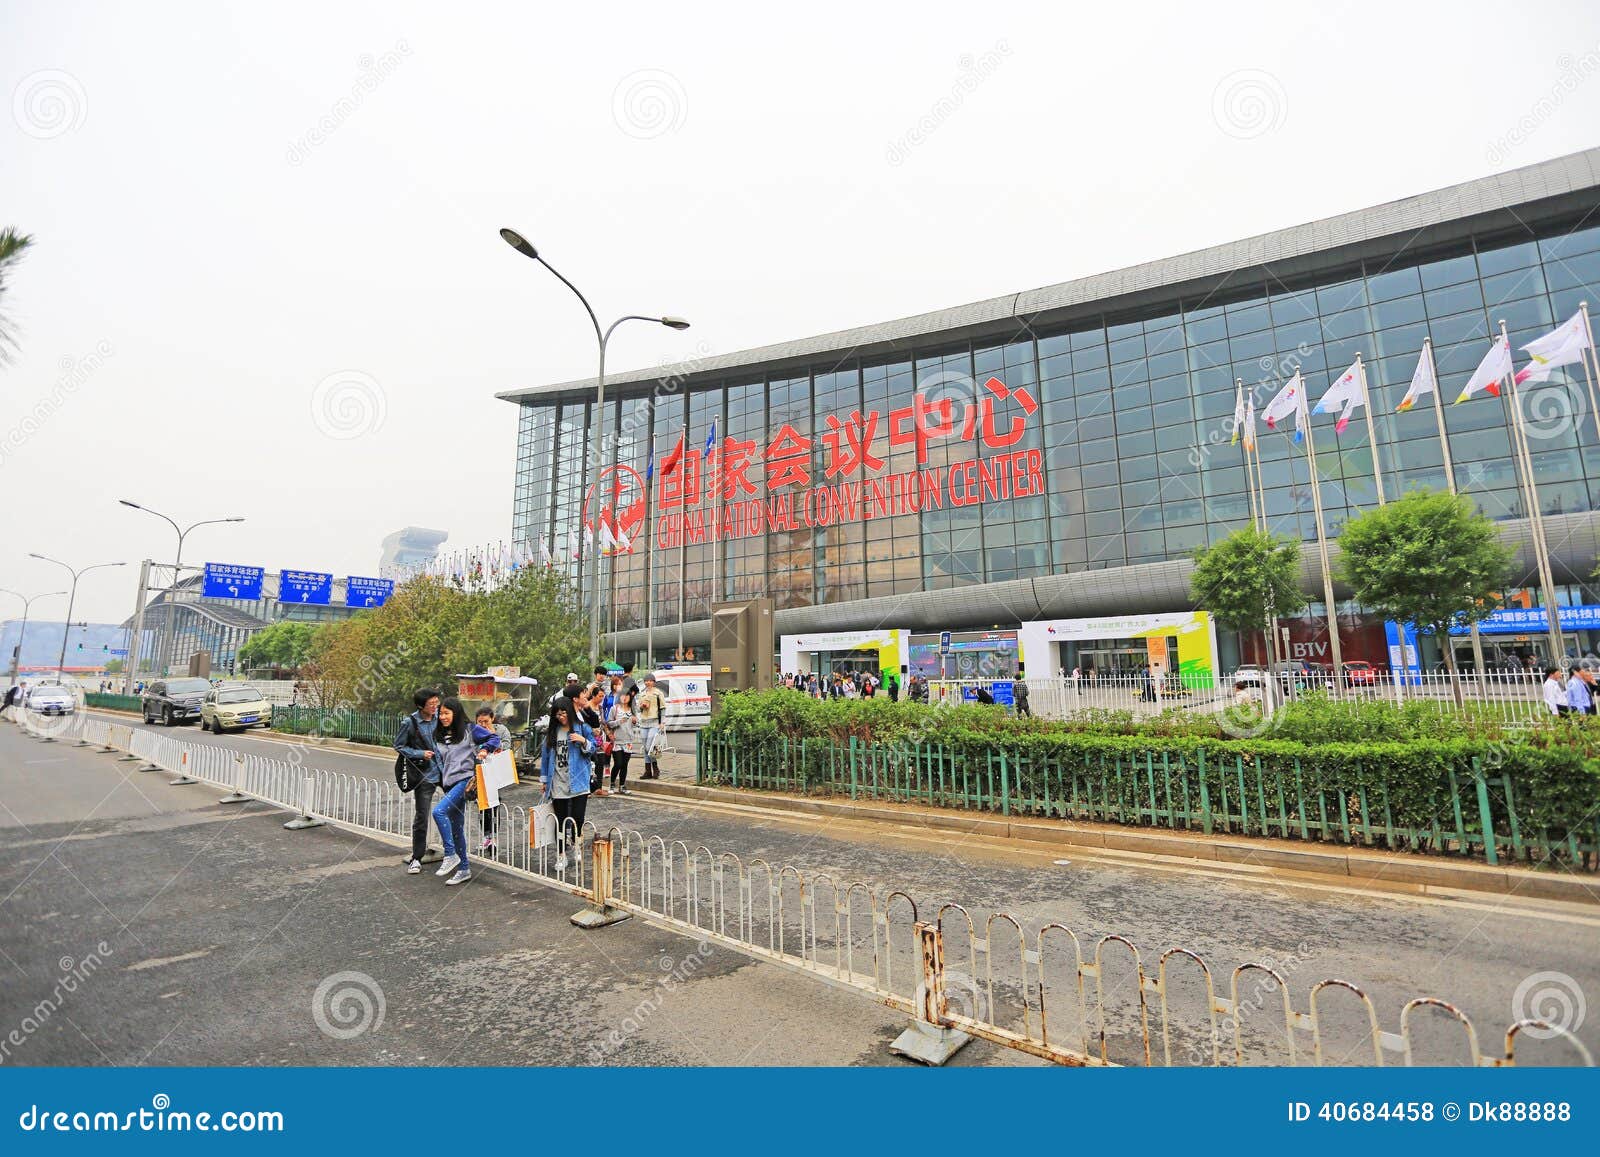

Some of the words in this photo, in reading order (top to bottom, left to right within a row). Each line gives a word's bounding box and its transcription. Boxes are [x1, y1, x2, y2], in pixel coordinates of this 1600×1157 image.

[658, 377, 1039, 510] 国家会议中心
[657, 507, 706, 549] CHINA
[710, 491, 799, 542] NATIONAL
[803, 466, 943, 528] CONVENTION
[948, 449, 1044, 507] CENTER
[1293, 641, 1328, 657] BTV
